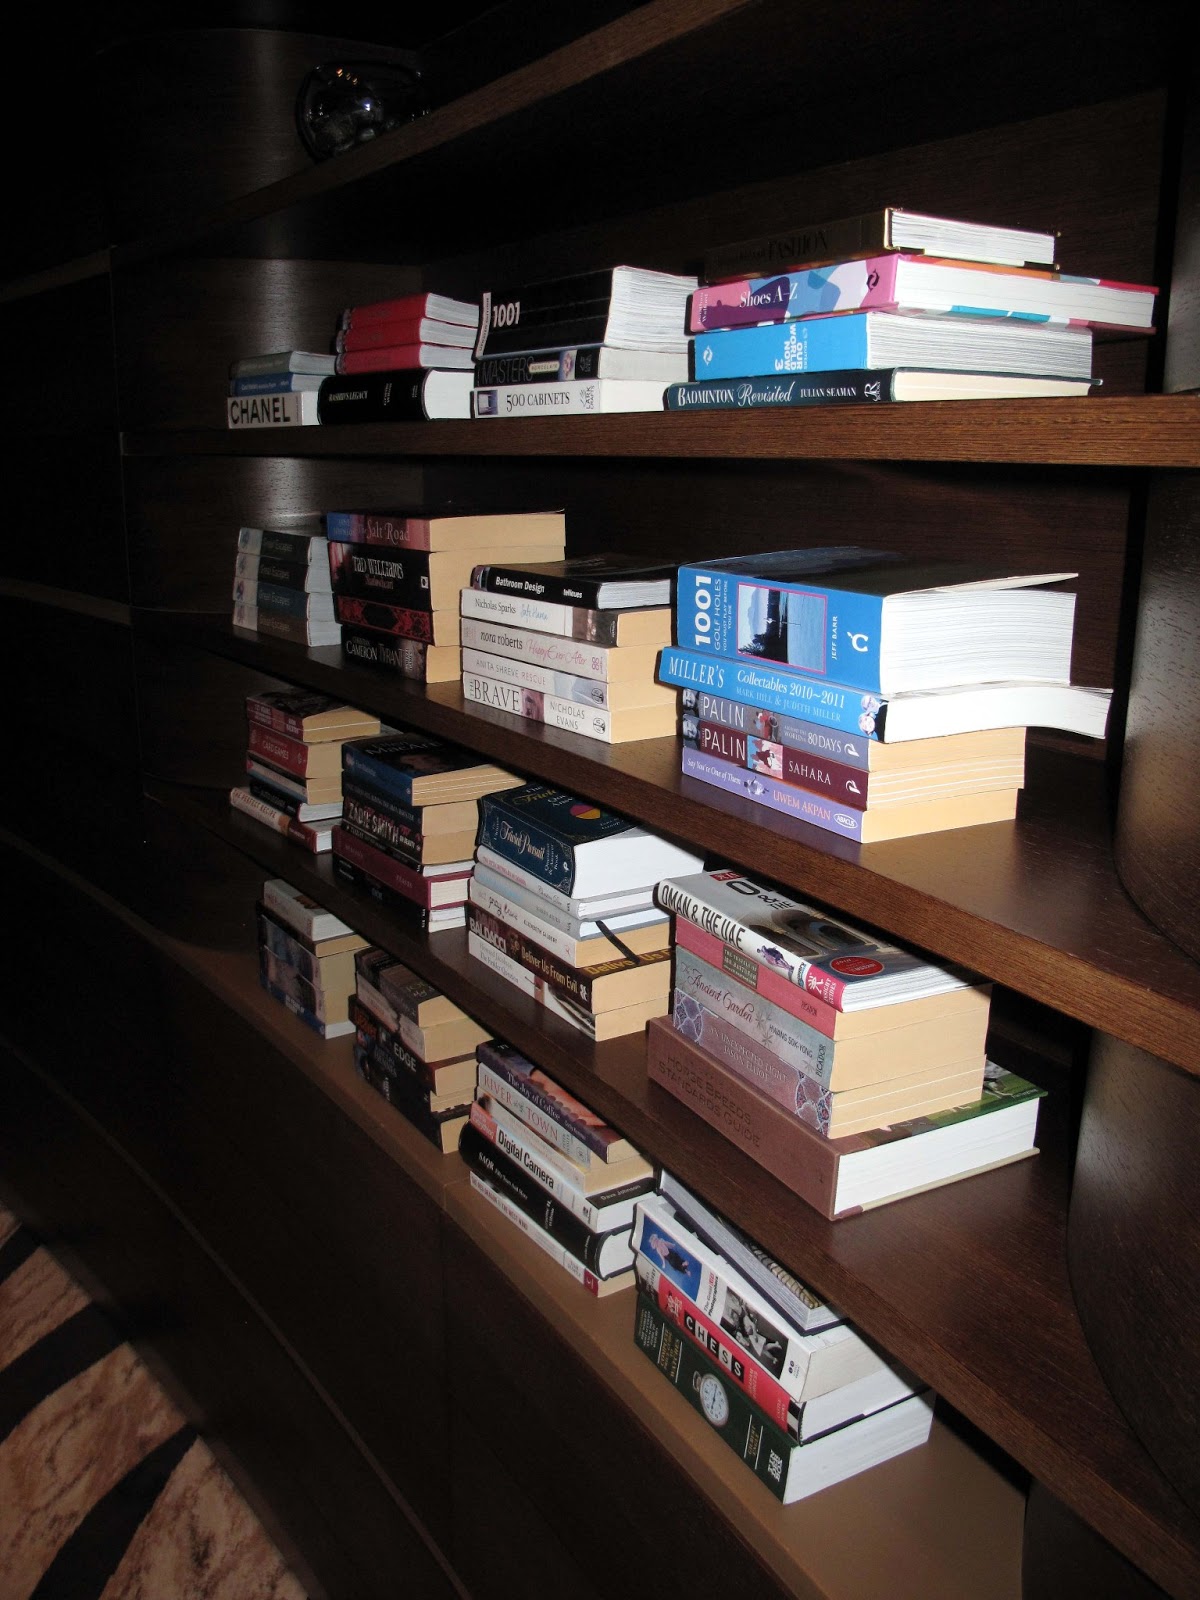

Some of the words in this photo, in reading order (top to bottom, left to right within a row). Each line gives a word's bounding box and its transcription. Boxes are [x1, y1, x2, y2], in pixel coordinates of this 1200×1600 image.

[492, 301, 520, 328] 1001
[739, 290, 772, 308] Shoes
[482, 356, 534, 384] MASTERS
[774, 358, 784, 371] 3
[506, 394, 526, 412] 500
[527, 392, 570, 406] CABINETS
[678, 386, 734, 406] BADMINTON
[737, 380, 796, 406] Revisited
[800, 388, 824, 398] JULIAN
[826, 386, 857, 397] SEAMAN
[230, 396, 291, 425] CHANEL
[366, 518, 382, 539] Salt
[384, 522, 410, 545] Road
[496, 576, 523, 590] Bathroom
[524, 580, 545, 594] Design
[474, 598, 498, 610] Nicholas
[498, 603, 516, 614] Sparks
[694, 575, 712, 646] 1001
[480, 630, 496, 644] nora
[497, 632, 523, 650] roberts
[565, 650, 588, 666] After
[476, 658, 494, 671] ANITA
[496, 664, 520, 679] SHREVE
[521, 671, 546, 686] RESCUE
[668, 656, 725, 688] MILLER'S
[737, 670, 788, 694] Collectables
[474, 678, 520, 714] BRAVE
[550, 700, 585, 720] NICHOLAS
[703, 696, 744, 728] PALIN
[736, 686, 754, 700] MARK
[756, 692, 772, 705] HILL
[774, 696, 782, 706] &
[783, 698, 811, 714] JUDITH
[812, 705, 841, 722] MILLER
[556, 716, 578, 730] EVANS
[704, 728, 746, 761] PALIN
[788, 760, 832, 786] SAHARA
[808, 732, 819, 746] 80
[818, 735, 842, 752] DAYS
[687, 758, 696, 768] Say
[710, 766, 721, 777] One
[722, 770, 728, 780] of
[728, 772, 742, 784] Them
[773, 790, 800, 810] UWEM
[801, 800, 831, 821] AKPAN
[836, 814, 856, 828] ABACUS
[372, 814, 399, 846] SMITH
[662, 884, 692, 919] OMAN
[691, 904, 698, 922] &
[702, 906, 722, 937] THE
[721, 919, 746, 951] UAE
[470, 916, 506, 954] BALDACCI
[522, 946, 542, 968] Deliver
[542, 959, 550, 974] Us
[550, 964, 566, 984] From
[566, 975, 578, 994] Evil
[584, 960, 637, 975] Delive
[687, 968, 722, 1001] Ancient
[722, 991, 755, 1022] Garden
[770, 1024, 788, 1042] HWANG
[815, 1044, 826, 1078] PICADOR
[394, 1041, 418, 1073] EDGE
[724, 1045, 745, 1065] JASON
[484, 1074, 512, 1106] RIVER
[526, 1107, 558, 1141] TOWN
[507, 1071, 520, 1087] The
[520, 1085, 530, 1100] Joy
[532, 1095, 540, 1105] of
[540, 1100, 561, 1120] Coffee
[706, 1081, 752, 1125] BREEDS
[724, 1111, 760, 1148] GUIDE
[498, 1129, 522, 1162] Digital
[523, 1152, 554, 1189] Camera
[708, 1276, 718, 1316] Photographers
[686, 1316, 741, 1377] CHESS
